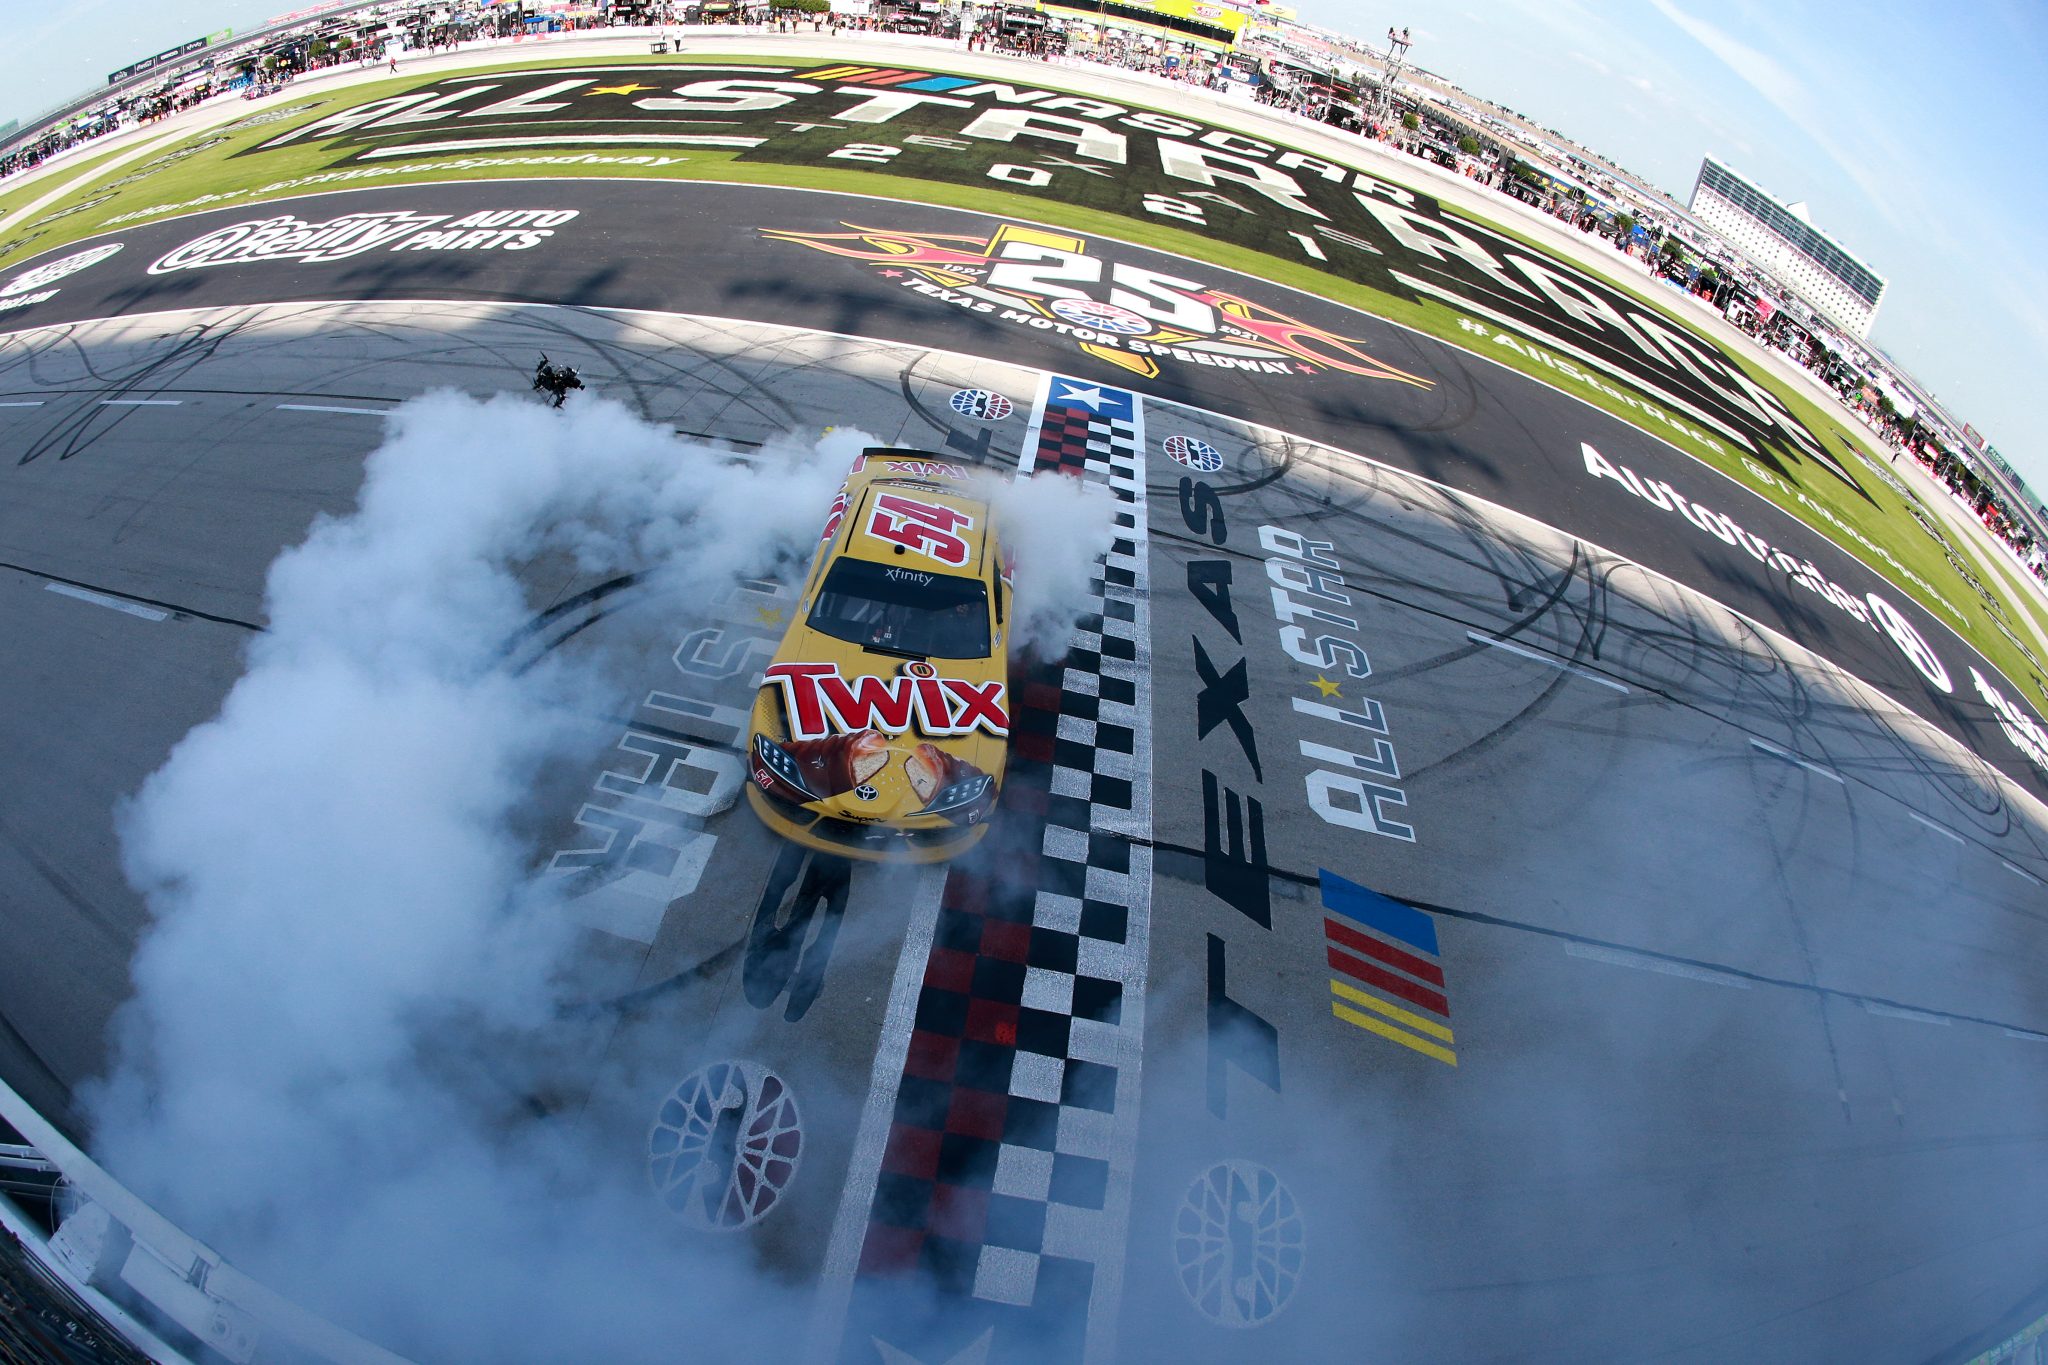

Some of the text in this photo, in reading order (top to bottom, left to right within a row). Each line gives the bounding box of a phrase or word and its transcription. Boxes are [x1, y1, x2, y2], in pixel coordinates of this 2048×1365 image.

[993, 46, 1044, 62] POPPY BANK
[257, 78, 601, 150] ALL
[633, 79, 1330, 221] STAR
[775, 121, 1383, 256] TEXAS
[948, 83, 1416, 210] NASCAR
[410, 229, 555, 251] PARTS
[443, 209, 580, 229] AUTO
[827, 143, 1328, 263] 2021
[943, 263, 987, 276] 1997
[987, 240, 1216, 334] 25
[901, 278, 1295, 377] TEXAS MOTOR SPEEDWAY
[1218, 325, 1260, 342] 2021
[1457, 317, 1726, 456] #AllStarRace
[865, 491, 974, 568] 54
[885, 567, 934, 587] xfinity
[1580, 442, 1878, 632] Autotrader
[1258, 525, 1372, 679] STAR
[756, 769, 774, 789] 54
[1180, 476, 1281, 1120] TEXAS
[1292, 697, 1416, 843] ALL
